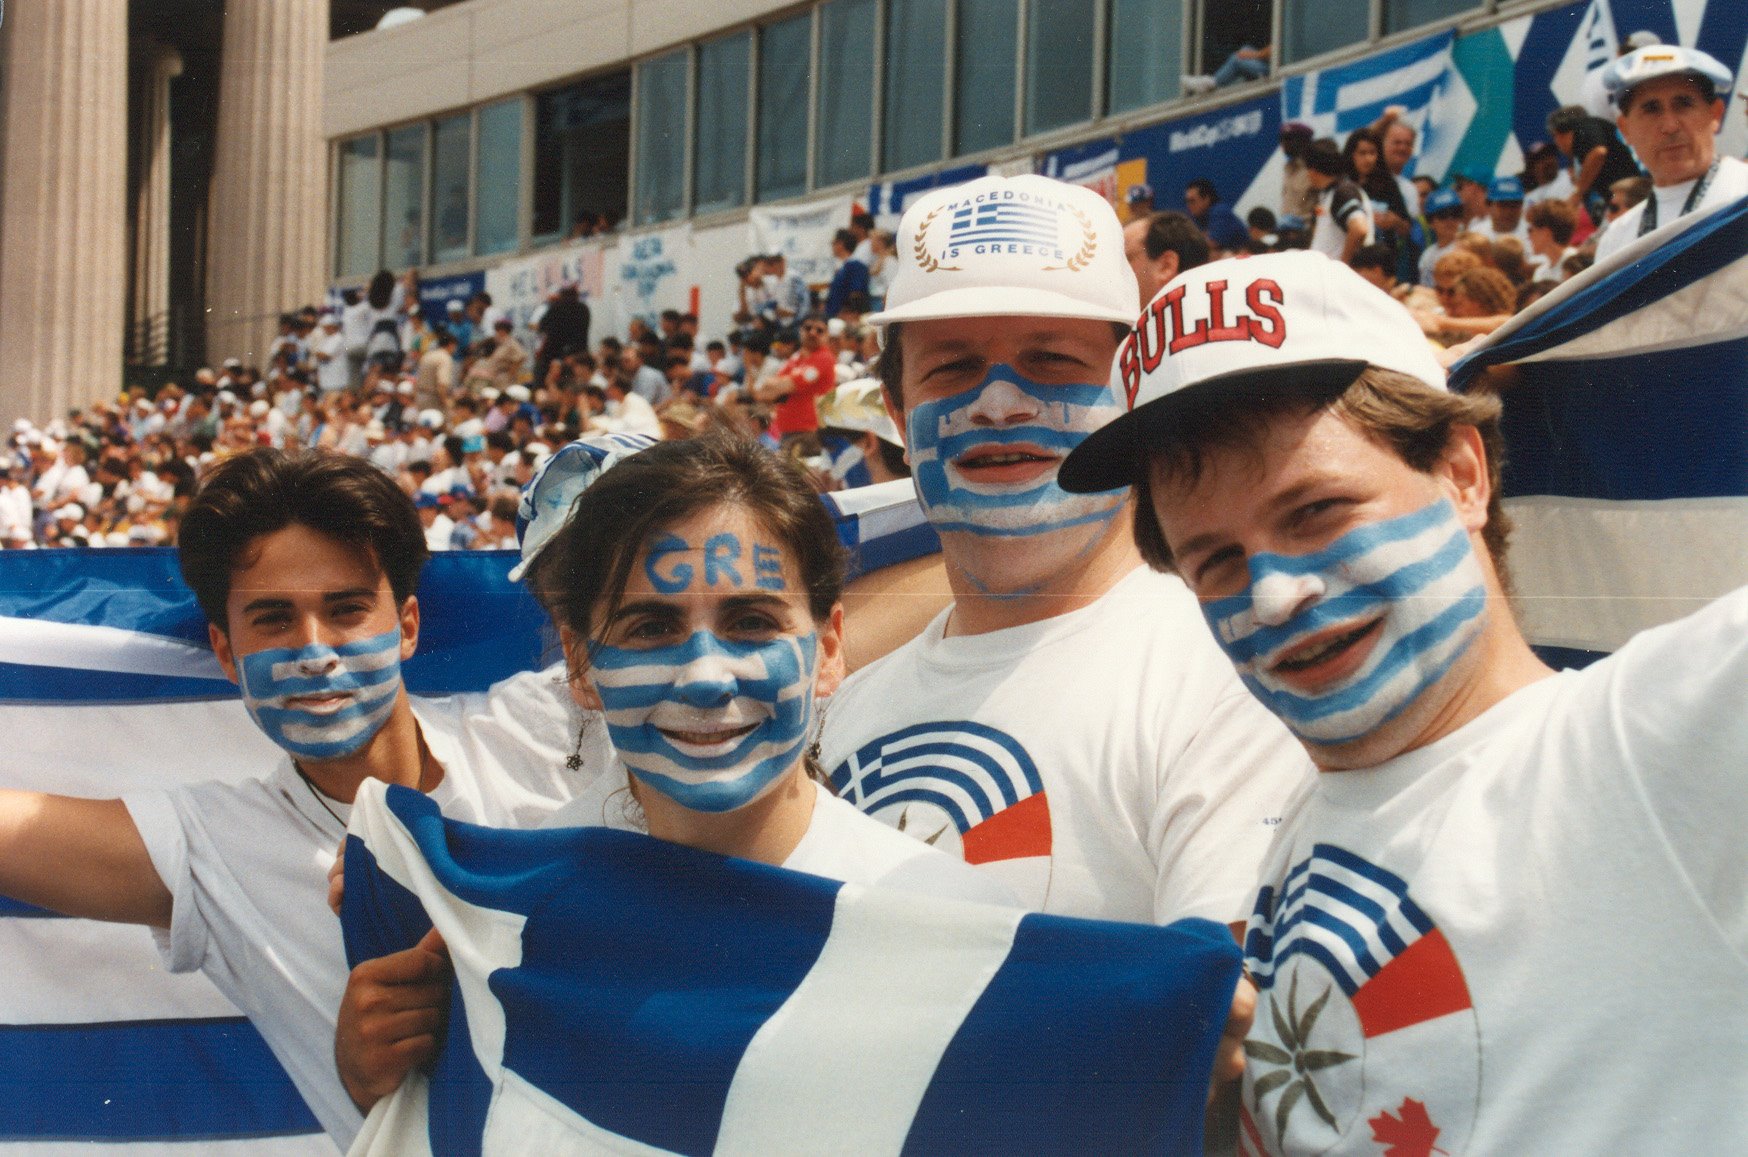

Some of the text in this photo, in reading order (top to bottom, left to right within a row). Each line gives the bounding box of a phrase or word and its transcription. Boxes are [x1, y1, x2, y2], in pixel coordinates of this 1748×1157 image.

[947, 190, 1066, 211] MACEDONIA
[941, 244, 1064, 260] IS GREECE
[1120, 278, 1287, 413] BULLS
[644, 532, 786, 596] GRE
